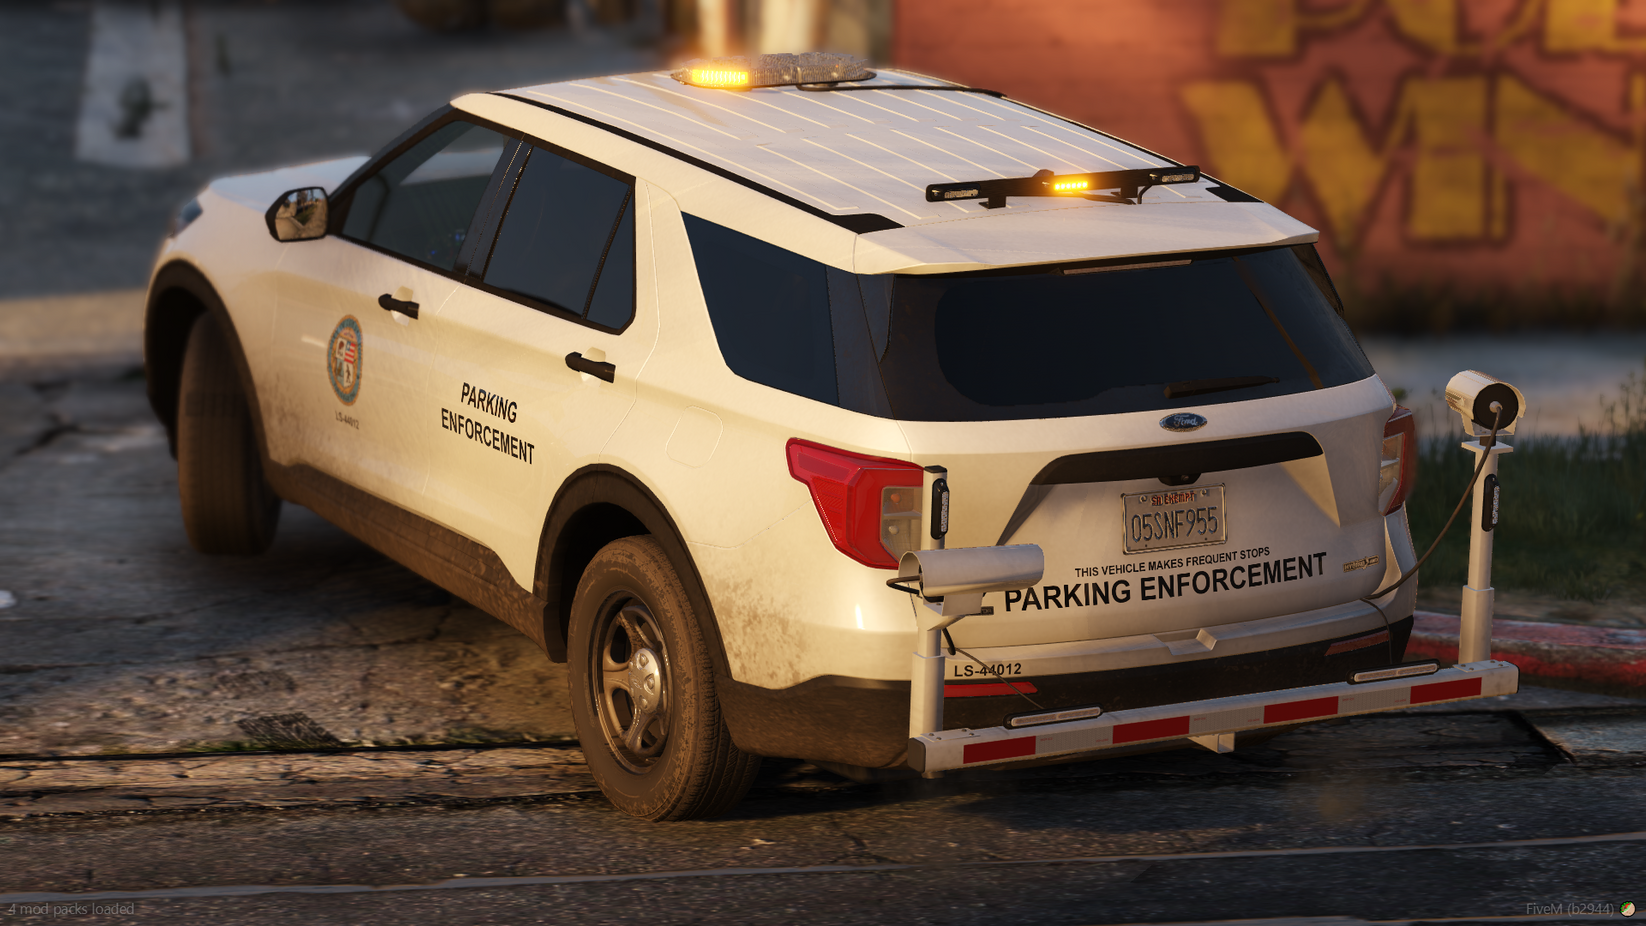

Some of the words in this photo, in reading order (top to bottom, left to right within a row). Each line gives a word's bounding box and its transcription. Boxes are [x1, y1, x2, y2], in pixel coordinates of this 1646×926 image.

[461, 382, 518, 423] PARKING
[441, 407, 535, 465] ENFORCEMENT
[1173, 414, 1199, 427] Ford
[1165, 491, 1196, 505] EXEMPT
[1131, 506, 1219, 543] 05SNF955
[1075, 567, 1099, 577] THIS
[1101, 562, 1146, 576] VEHICLE
[1148, 558, 1184, 571] MAKES
[1186, 551, 1238, 566] FREQUENT
[1240, 546, 1270, 560] STOPS
[1005, 579, 1132, 612] PARKING
[1140, 552, 1327, 601] ENFORCEMENT
[954, 663, 1022, 677] LS-44012
